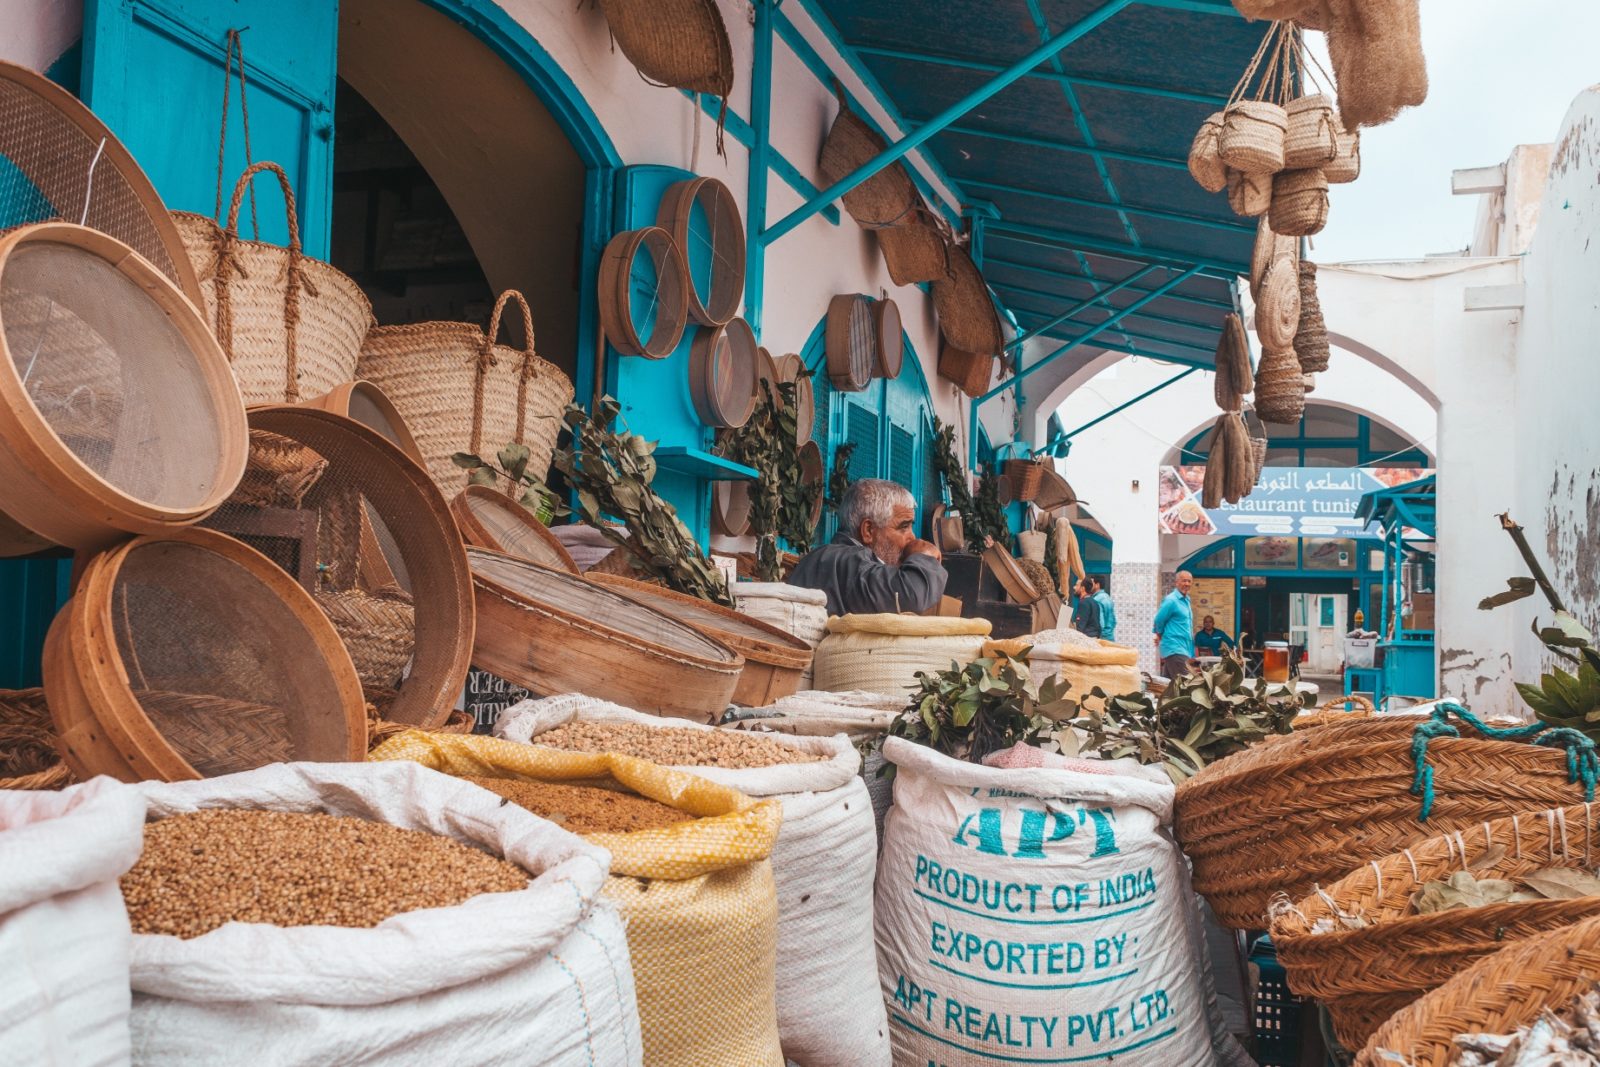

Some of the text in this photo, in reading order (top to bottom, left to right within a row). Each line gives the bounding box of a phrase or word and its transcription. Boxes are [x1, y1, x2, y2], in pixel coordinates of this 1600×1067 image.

[1209, 498, 1359, 514] estaurant tunis
[1252, 471, 1301, 496] التون
[952, 806, 1121, 860] APT
[914, 854, 1157, 914] PRODUCT OF INDIA
[931, 921, 1086, 976] EXPORTED
[893, 975, 1175, 1048] APT REALTY PVT. LTD.
